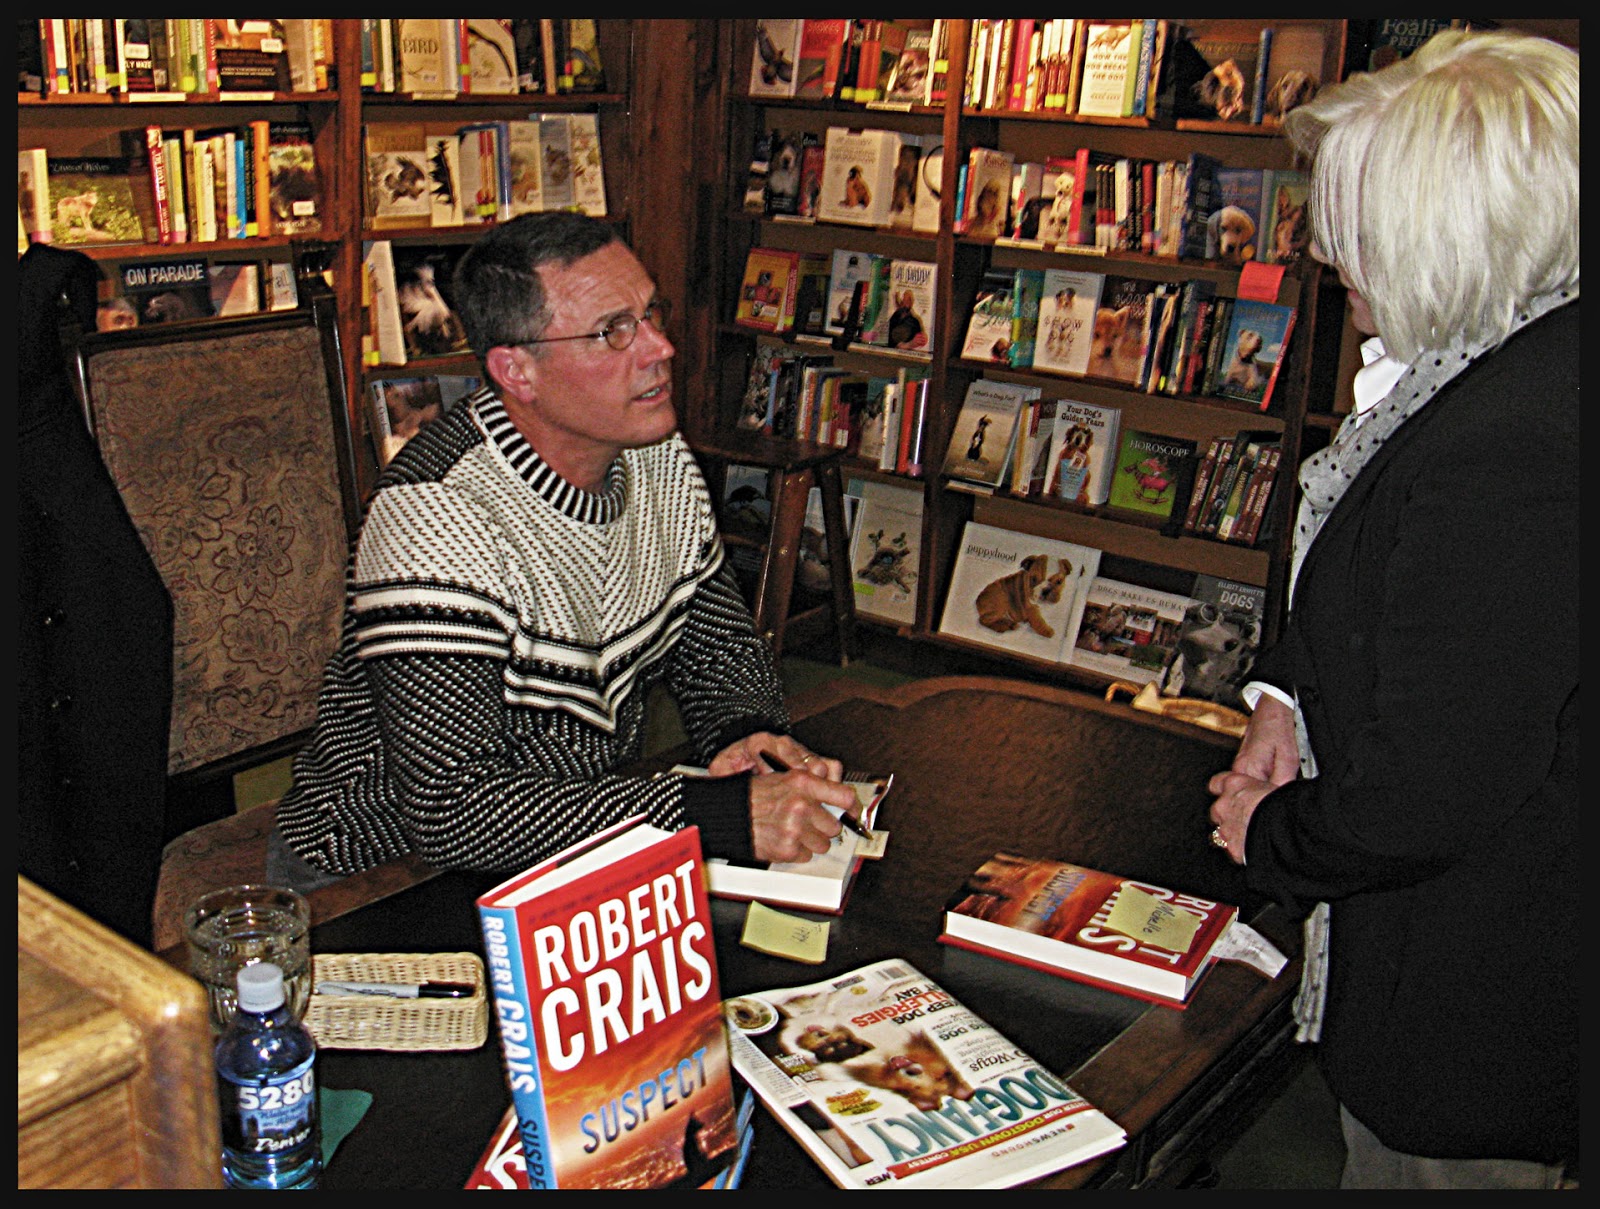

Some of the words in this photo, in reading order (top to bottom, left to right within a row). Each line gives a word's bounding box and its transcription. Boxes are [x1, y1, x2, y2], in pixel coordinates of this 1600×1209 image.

[403, 38, 439, 54] BIRD
[126, 268, 147, 286] ON
[150, 264, 205, 283] PARADE
[1061, 412, 1084, 423] Golden
[1085, 416, 1105, 427] Years
[1067, 404, 1083, 415] Your
[1084, 407, 1103, 419] Dog's
[1130, 440, 1190, 457] HOROSCOPE
[967, 544, 1017, 562] puppyhood
[1220, 590, 1255, 610] DOGS
[533, 859, 696, 990] ROBERT
[541, 921, 712, 1072] CRAIS
[895, 986, 921, 1001] BAY
[482, 916, 515, 1003] ROBERT
[499, 1001, 536, 1094] CRAIS
[892, 1008, 926, 1025] DOG
[938, 1026, 969, 1041] DOG
[969, 1052, 1015, 1072] Ways
[240, 1068, 315, 1110] 5280
[579, 1046, 707, 1154] SUSPECT
[980, 1116, 1045, 1146] DOGTOWN
[950, 1142, 979, 1156] USA
